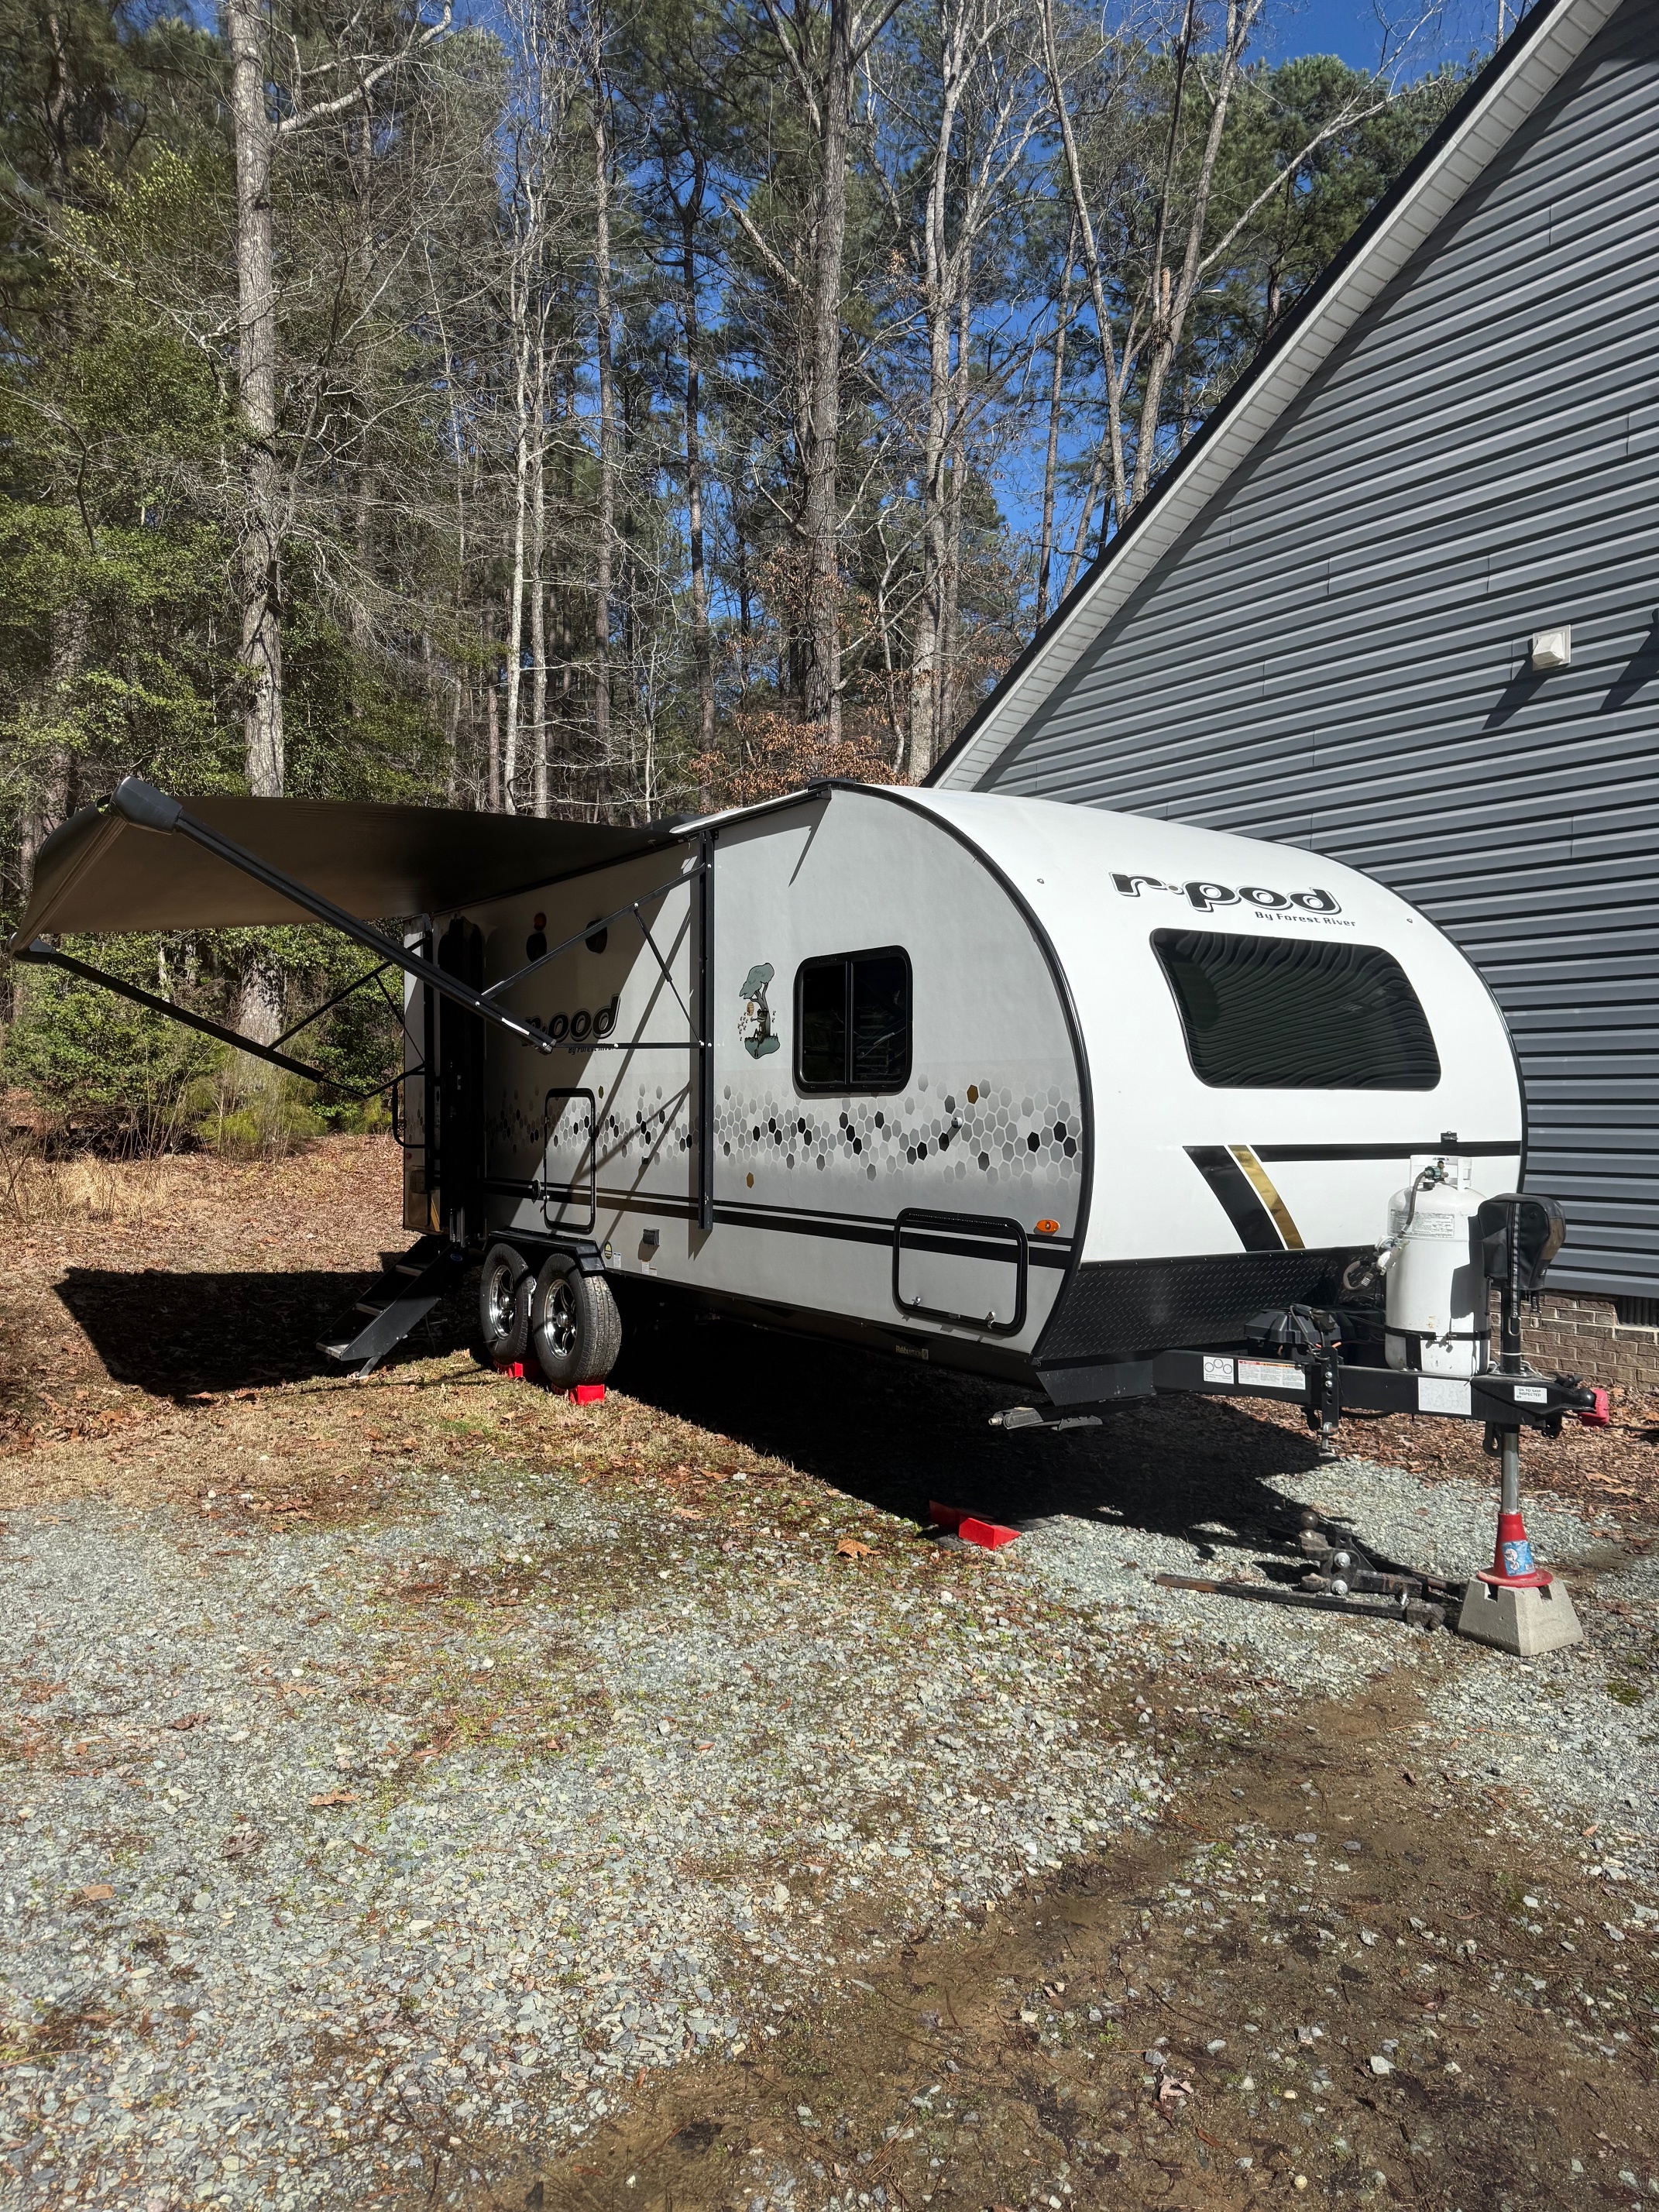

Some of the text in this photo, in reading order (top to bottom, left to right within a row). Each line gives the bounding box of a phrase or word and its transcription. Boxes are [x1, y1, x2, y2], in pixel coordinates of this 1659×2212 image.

[1254, 911, 1356, 926] By Forest River
